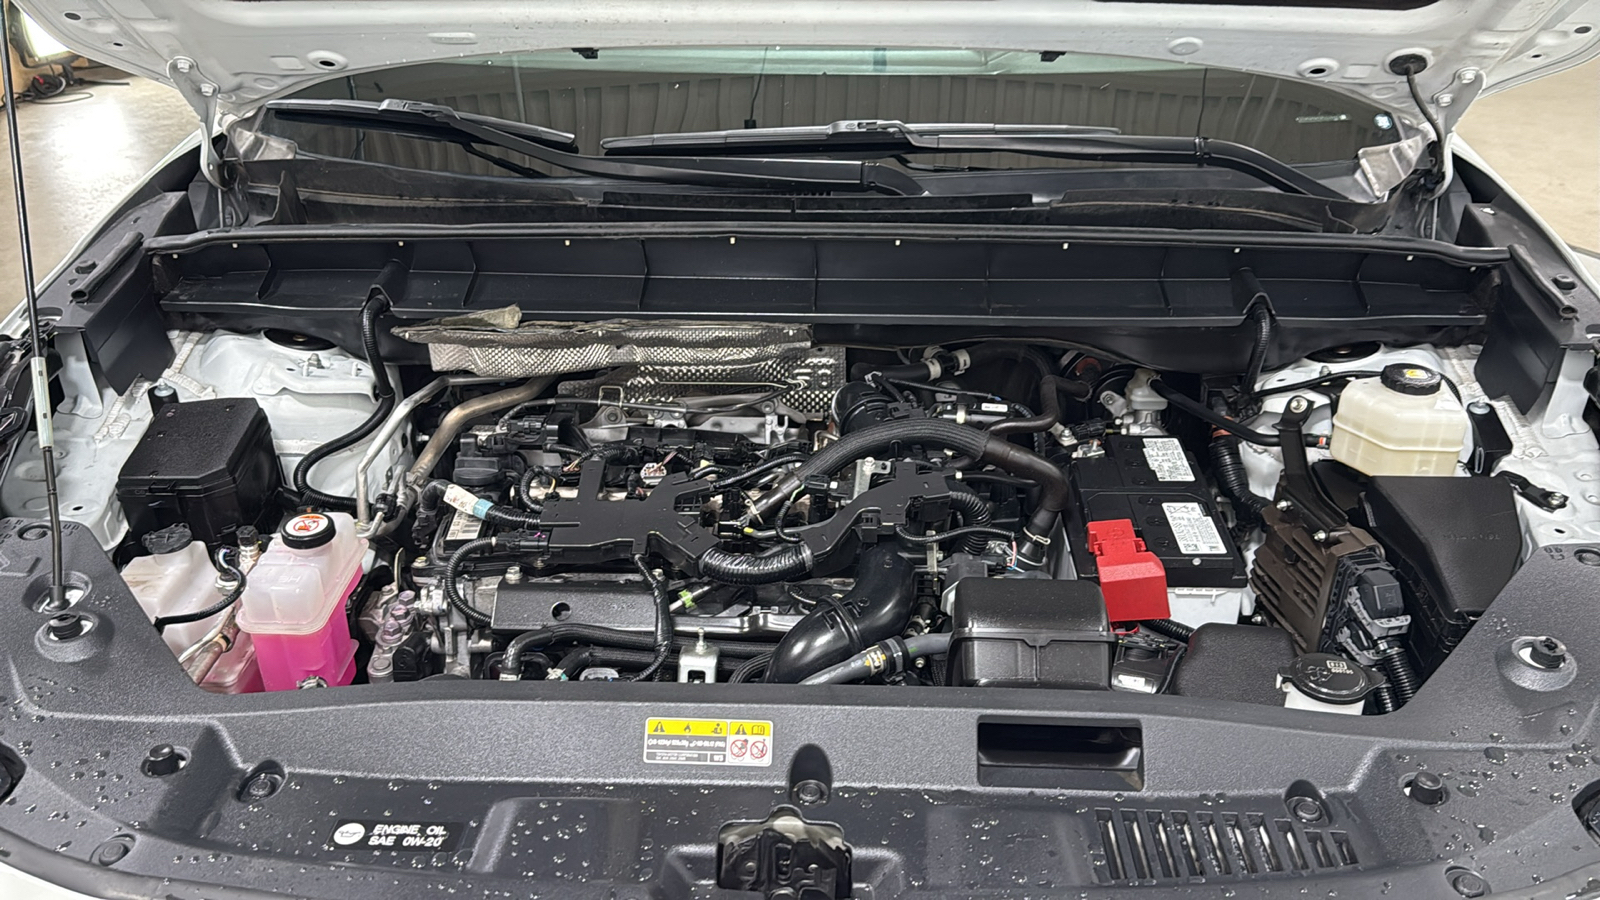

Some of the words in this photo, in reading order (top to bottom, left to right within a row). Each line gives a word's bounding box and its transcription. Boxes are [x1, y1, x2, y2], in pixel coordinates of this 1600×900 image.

[373, 824, 421, 835] ENGINE
[426, 825, 447, 836] OIL
[368, 836, 397, 846] SAE
[402, 836, 443, 847] 0W-20
